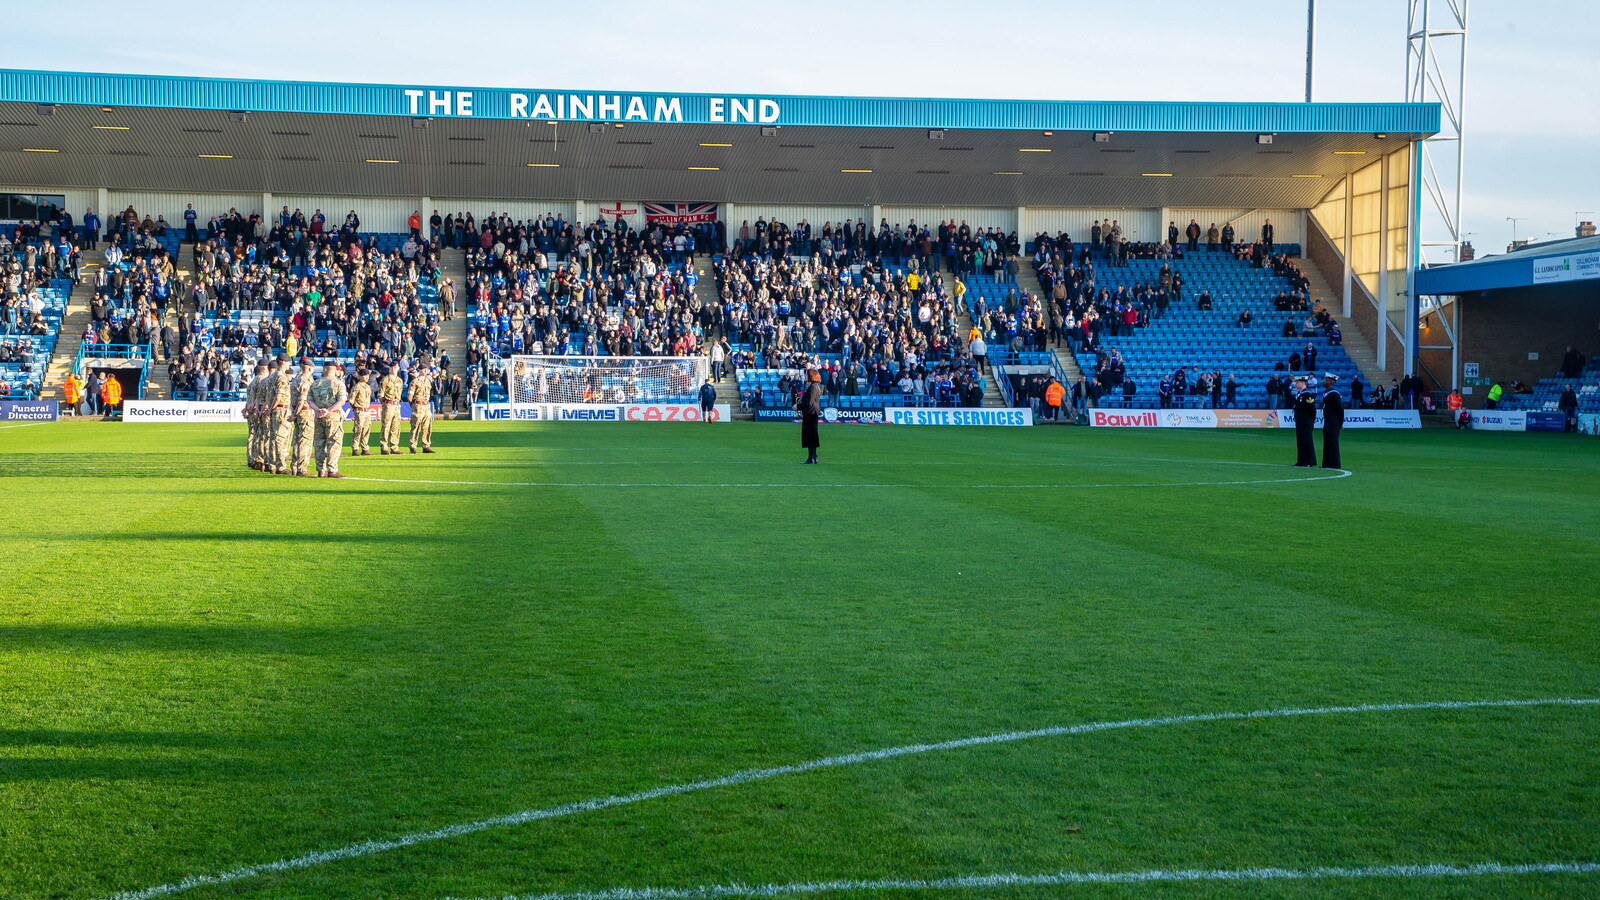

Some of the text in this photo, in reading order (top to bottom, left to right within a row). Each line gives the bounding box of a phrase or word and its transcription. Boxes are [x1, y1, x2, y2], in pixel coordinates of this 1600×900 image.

[404, 89, 782, 124] THE RAINHAM END
[1576, 256, 1600, 264] GILLINGHAM
[12, 404, 49, 412] Funeral
[129, 407, 187, 416] Rochester
[193, 408, 231, 416] practical
[8, 411, 52, 420] Directors
[484, 408, 538, 420] MEMS
[562, 408, 615, 420] MEMS
[837, 410, 882, 419] SOLUTIONS
[893, 410, 1025, 426] PG SITE SERVICES
[1094, 411, 1158, 427] Bauvill
